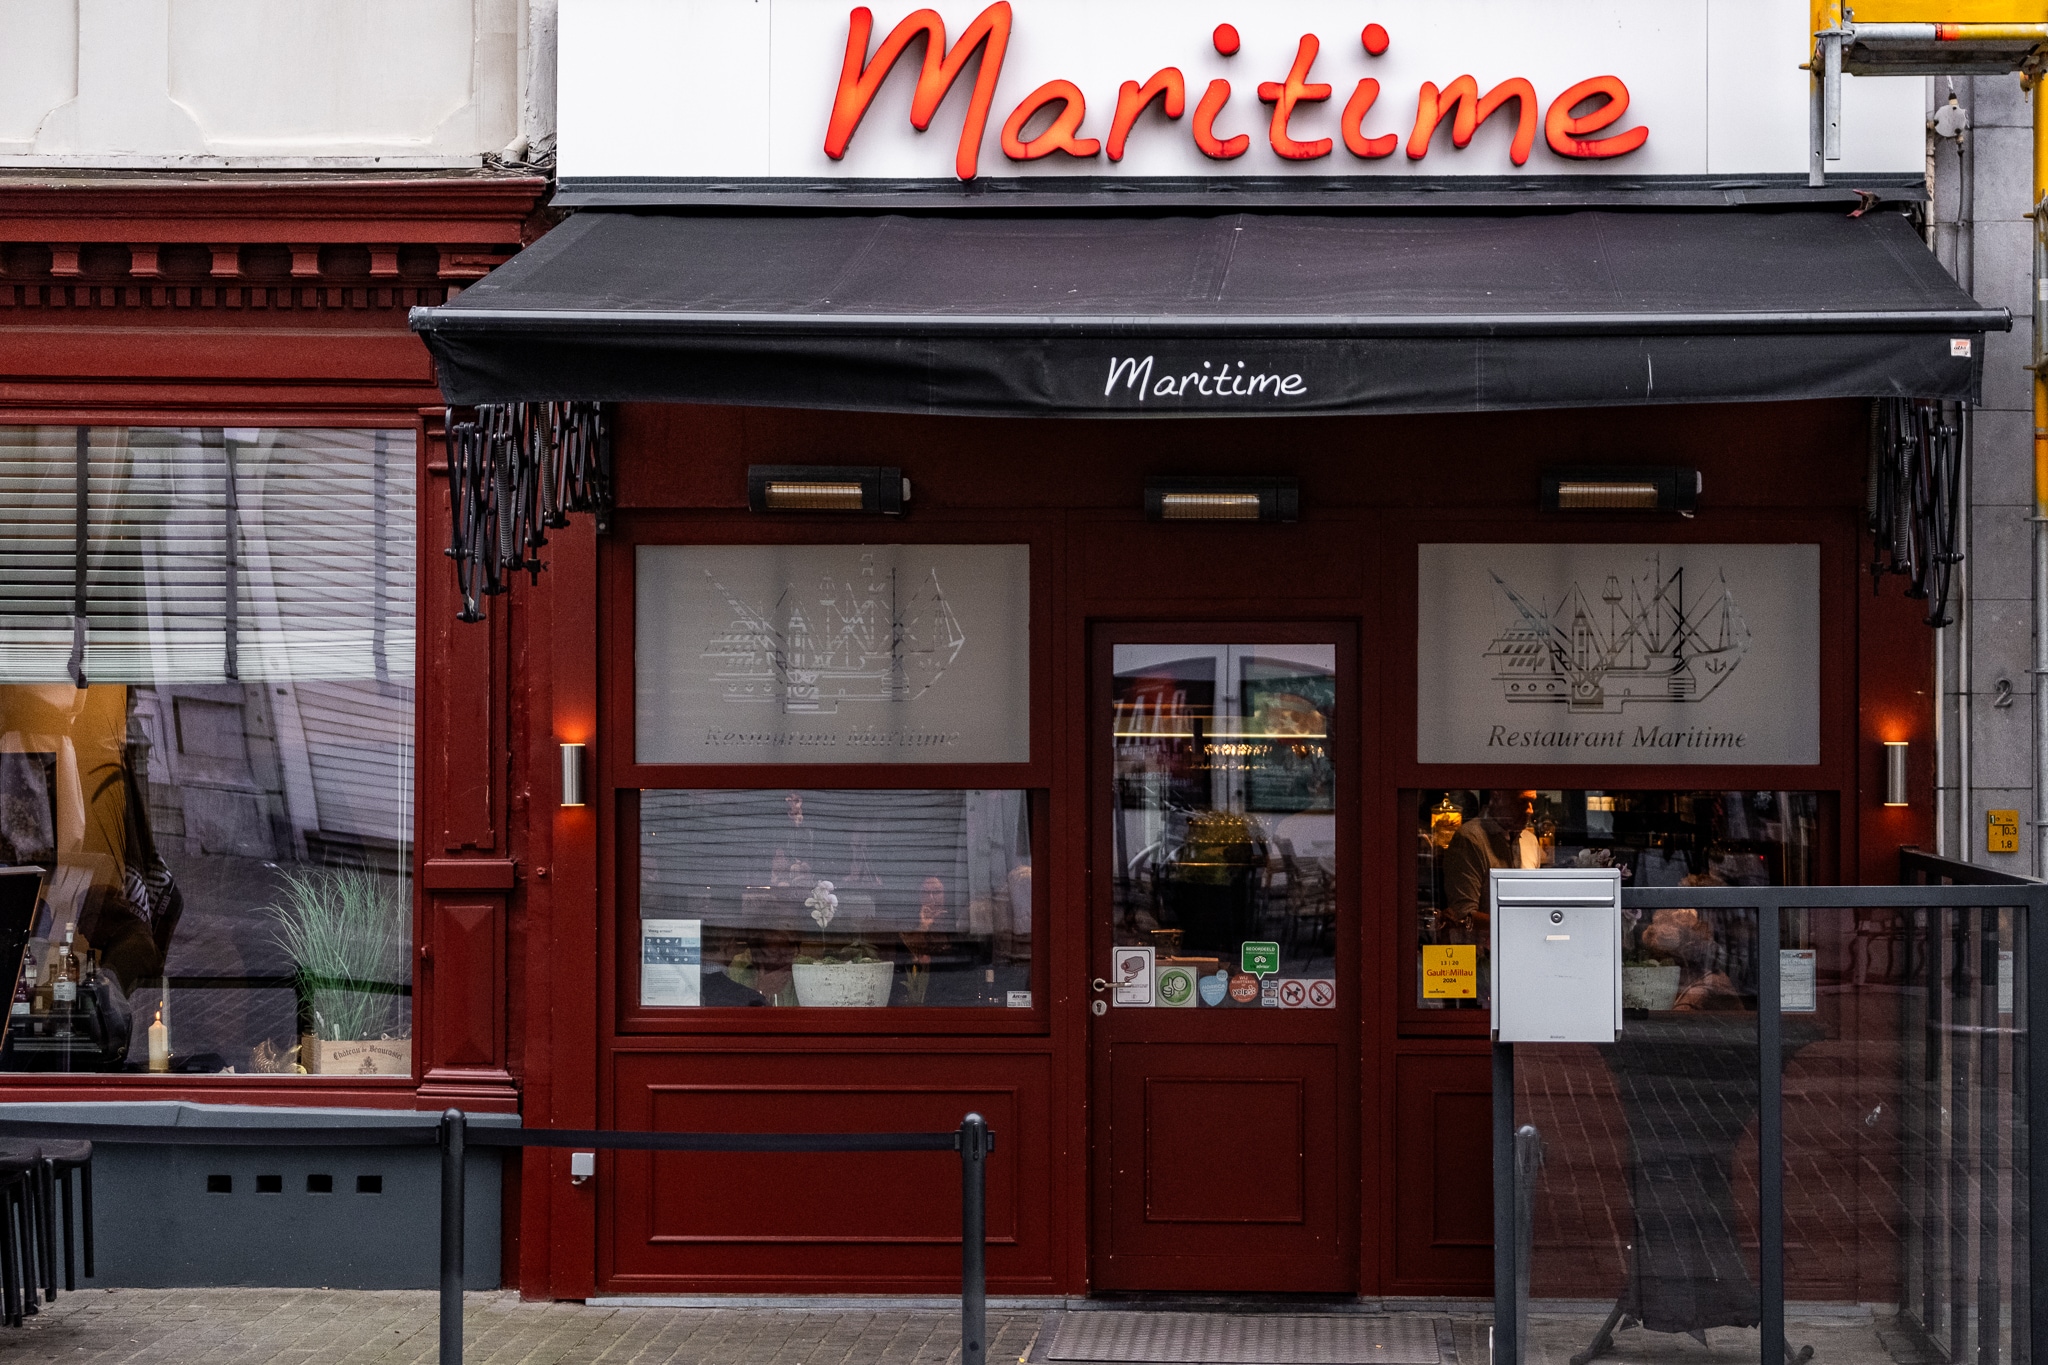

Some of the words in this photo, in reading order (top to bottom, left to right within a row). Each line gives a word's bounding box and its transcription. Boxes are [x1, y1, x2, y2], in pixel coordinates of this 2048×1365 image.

[823, 1, 1650, 181] Maritime
[1104, 355, 1307, 401] Maritime
[1994, 677, 2013, 709] 2
[1487, 724, 1625, 747] Restaurant
[1632, 724, 1748, 747] Maritime
[2001, 840, 2012, 849] 1.8
